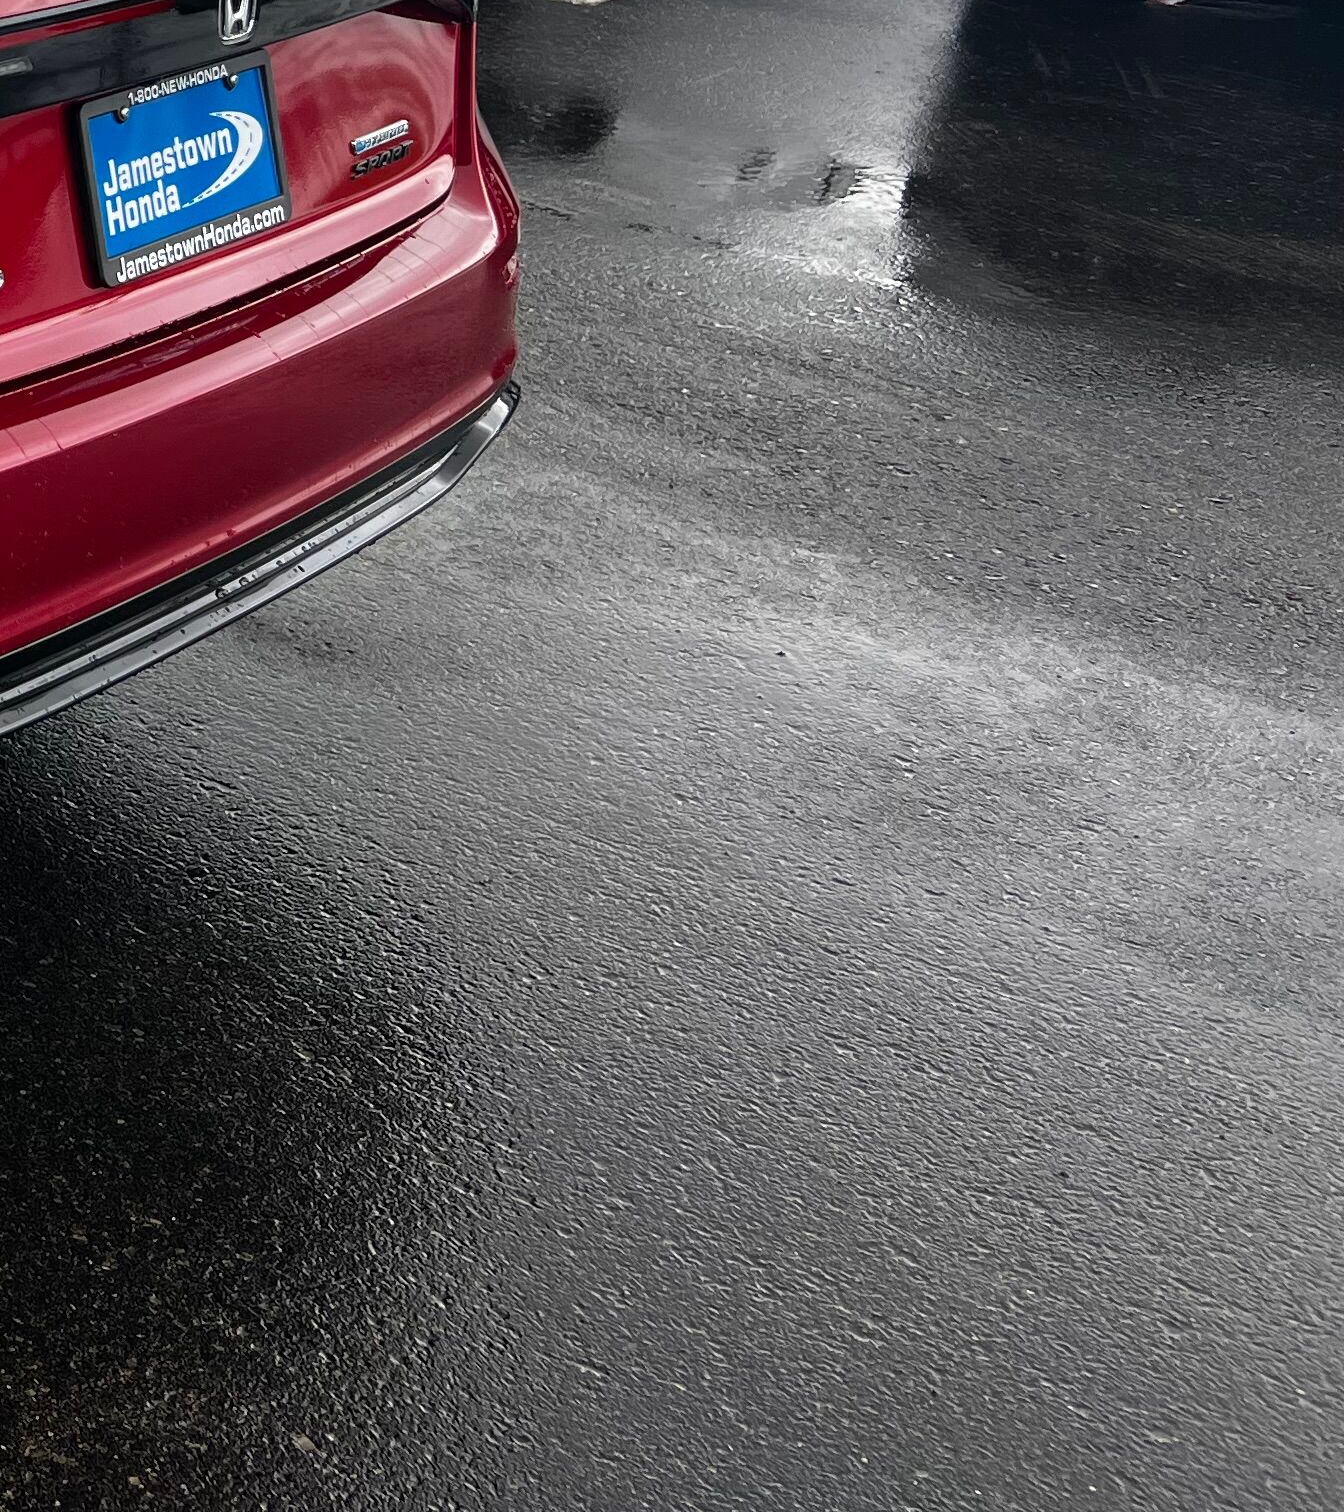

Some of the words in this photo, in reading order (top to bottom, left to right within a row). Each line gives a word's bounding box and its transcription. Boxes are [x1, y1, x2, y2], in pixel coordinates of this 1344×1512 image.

[127, 64, 229, 106] 1-800-NEW-HONDA
[103, 127, 233, 197] Jamestown
[351, 139, 414, 180] SPORT
[105, 179, 181, 236] Honda
[116, 204, 285, 283] JamestownHonda.com
